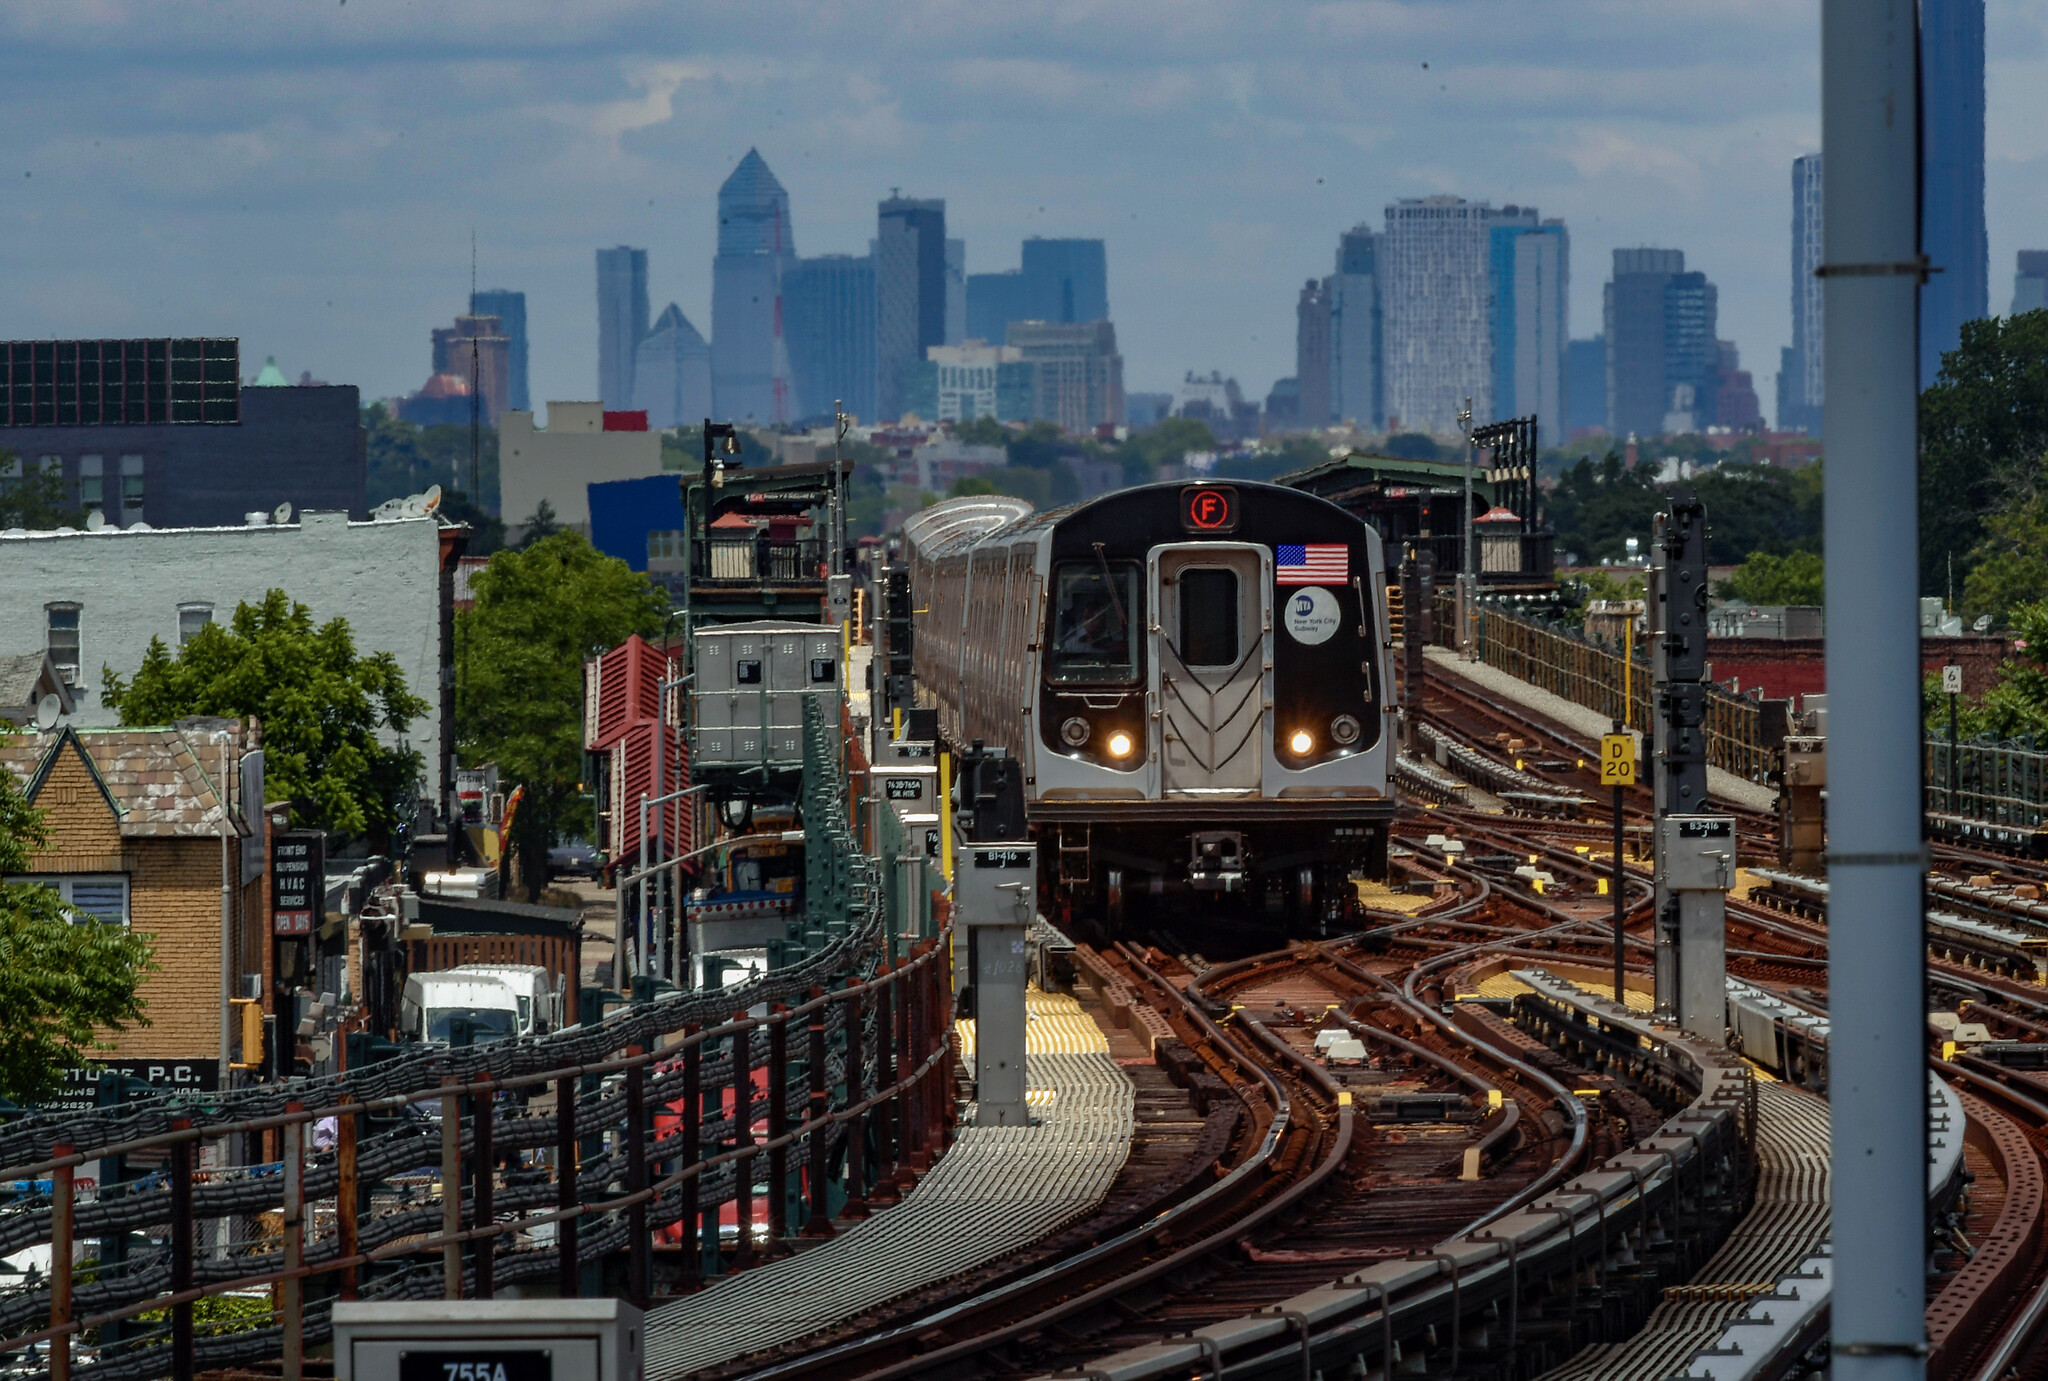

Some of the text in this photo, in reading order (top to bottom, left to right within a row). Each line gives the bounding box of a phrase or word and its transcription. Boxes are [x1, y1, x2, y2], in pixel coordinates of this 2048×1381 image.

[1202, 498, 1217, 521] F
[1295, 599, 1312, 613] MTA
[1948, 670, 1956, 681] 6
[1612, 743, 1623, 758] D
[1606, 761, 1630, 777] 20
[1701, 829, 1708, 838] J
[277, 845, 307, 856] FRONT END
[276, 861, 309, 872] SUSPENSION
[280, 895, 305, 906] SERVICES
[276, 914, 309, 931] OPEN DAYS
[149, 1066, 201, 1082] P.C.
[443, 1363, 508, 1381] 755A
